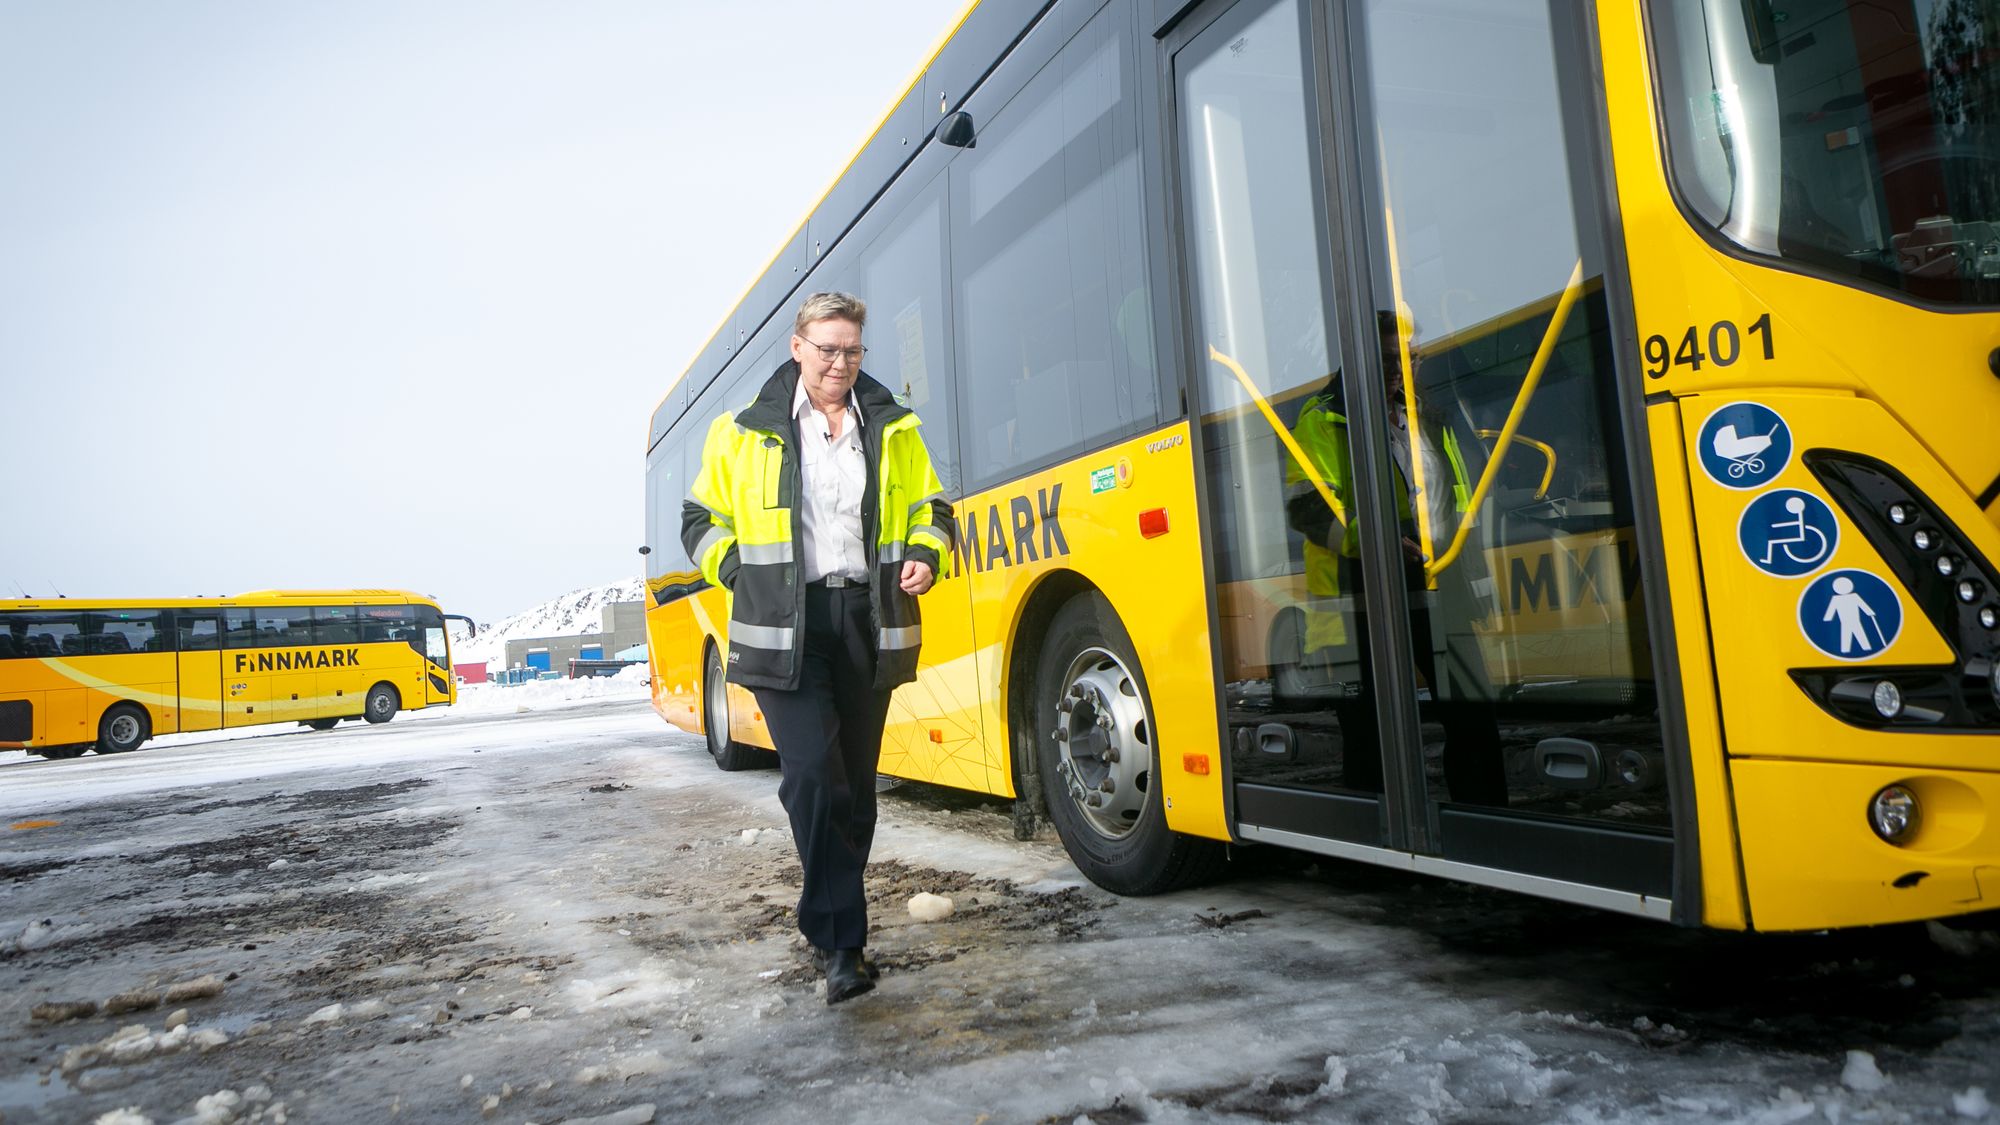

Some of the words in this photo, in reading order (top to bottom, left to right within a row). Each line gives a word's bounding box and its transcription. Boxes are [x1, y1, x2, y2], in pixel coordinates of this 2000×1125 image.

[1644, 313, 1775, 380] 9401
[1145, 434, 1183, 454] VOLVO
[944, 482, 1071, 579] MARK
[235, 648, 360, 673] FINNMARK
